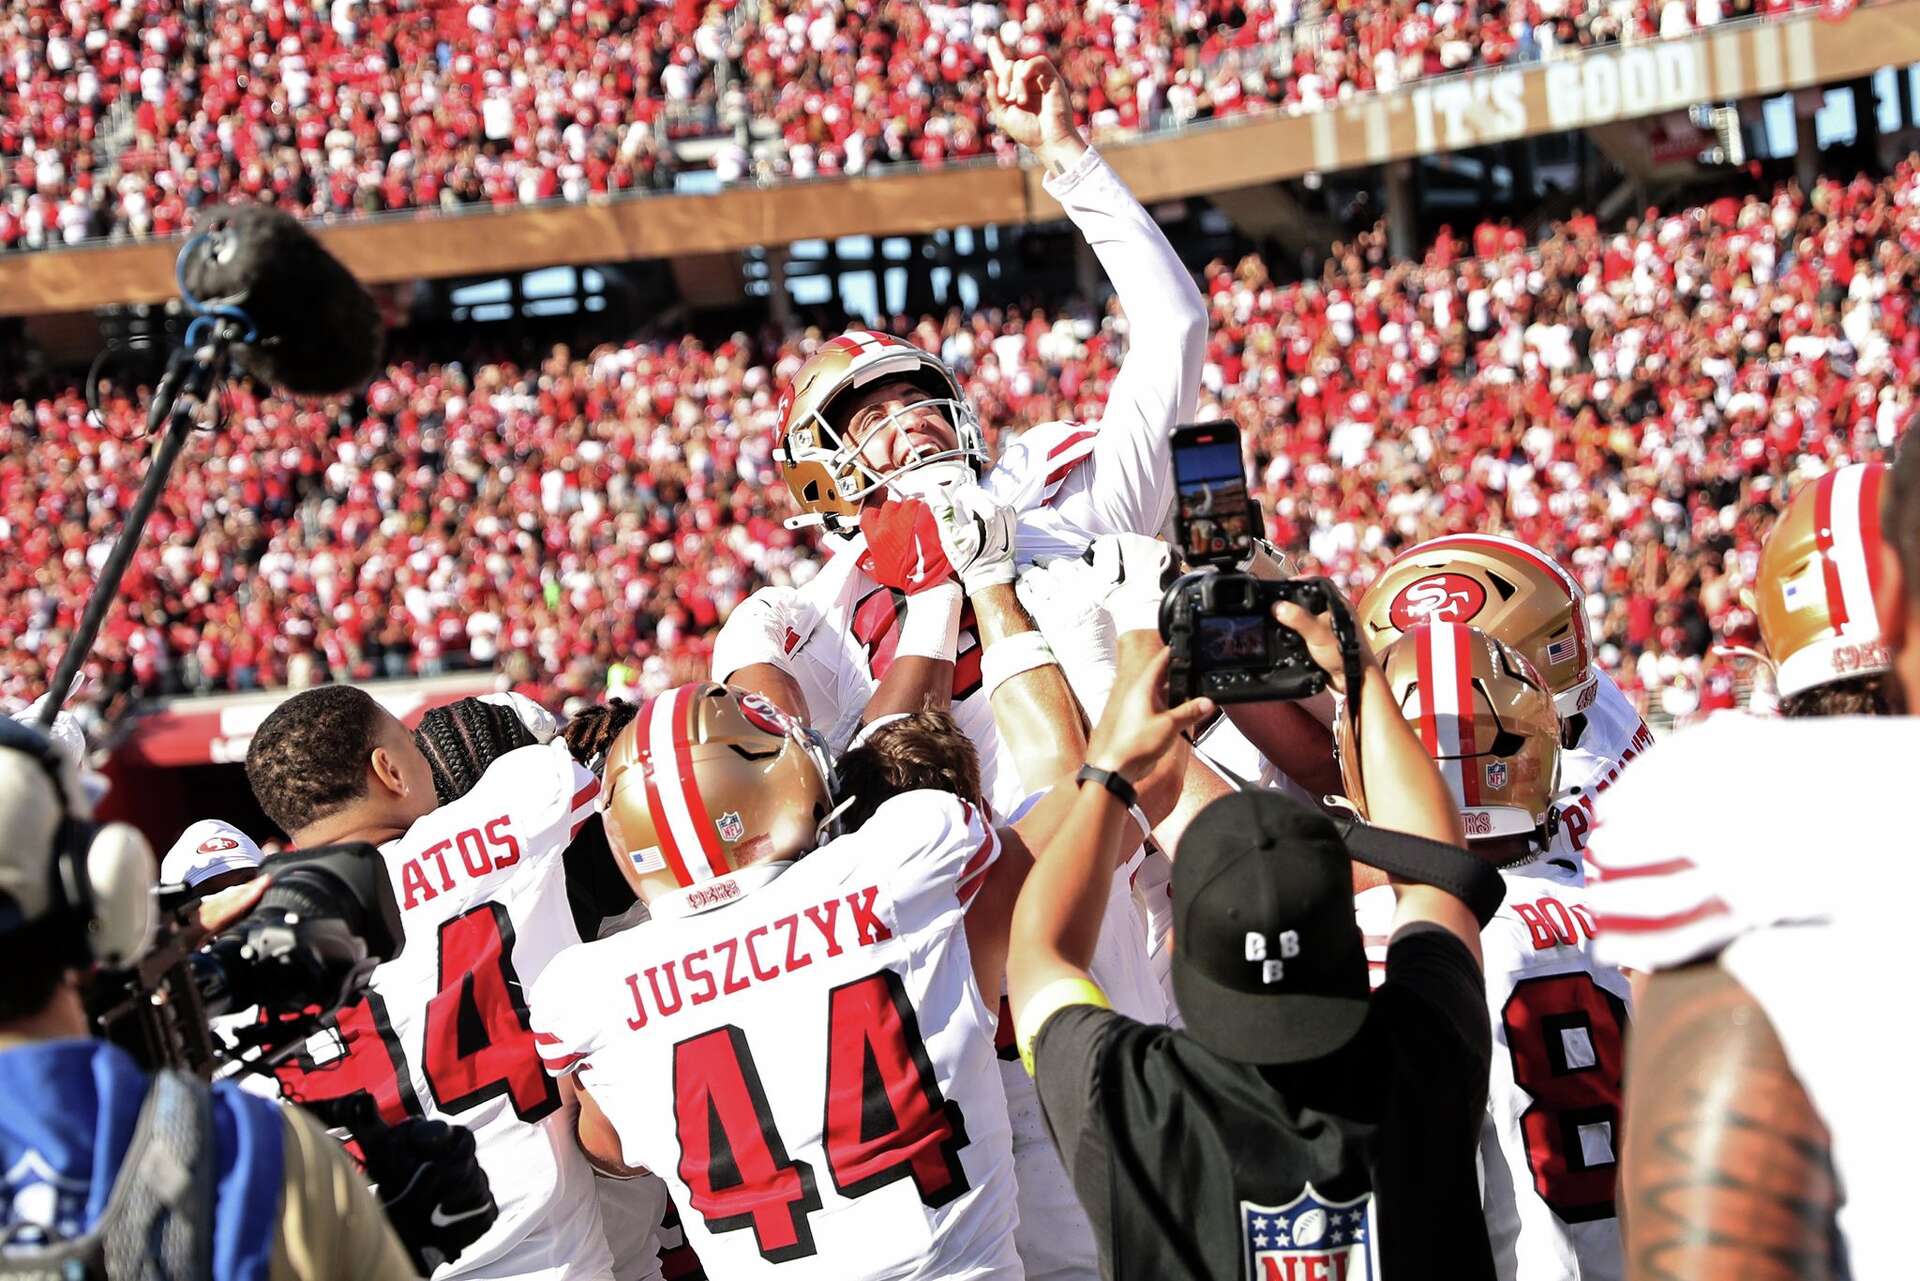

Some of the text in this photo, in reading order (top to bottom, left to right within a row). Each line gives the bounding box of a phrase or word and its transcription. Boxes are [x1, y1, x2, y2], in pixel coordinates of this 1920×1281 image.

[1412, 42, 1697, 152] IT'S GOOD
[402, 814, 520, 911] ATOS
[722, 824, 742, 840] NFL
[625, 885, 893, 1031] JUSZCZYK
[673, 967, 971, 1264] 44
